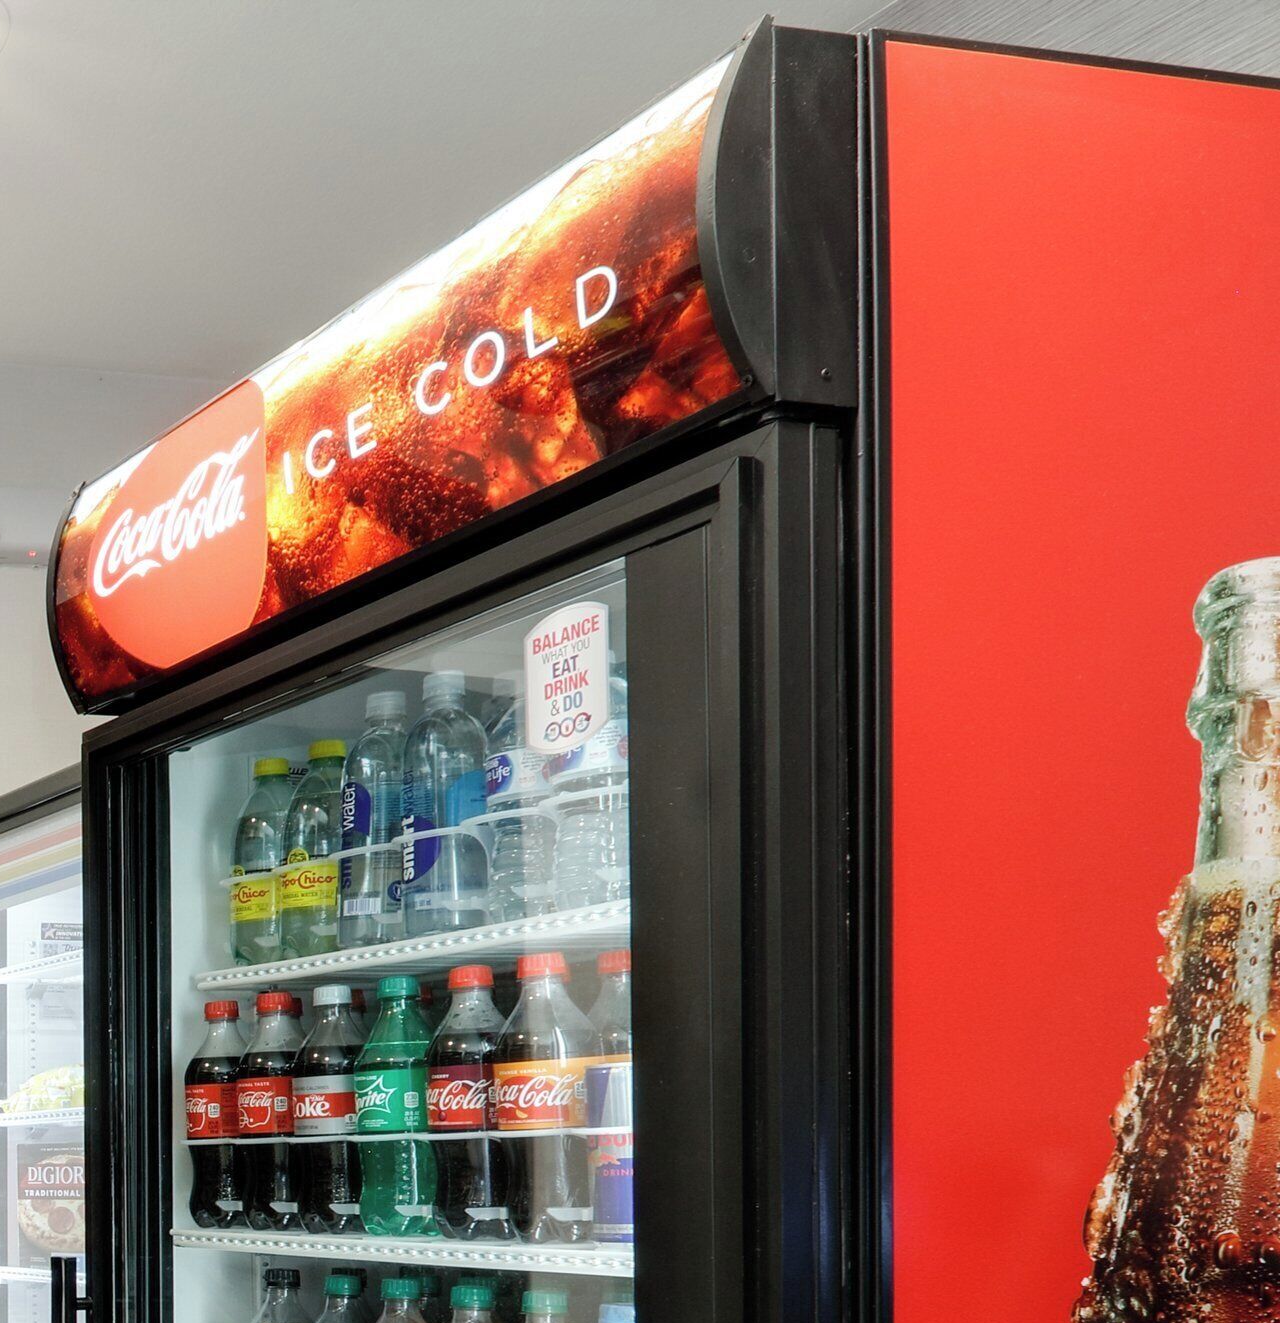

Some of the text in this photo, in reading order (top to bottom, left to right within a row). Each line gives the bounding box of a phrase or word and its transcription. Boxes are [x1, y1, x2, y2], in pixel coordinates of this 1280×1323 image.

[282, 264, 619, 495] ICE COLD
[93, 427, 260, 597] Coca-Cola
[532, 614, 600, 655] BALANCE
[541, 637, 591, 665] WHAT YOU
[544, 670, 589, 700] DRINK
[550, 691, 583, 716] & DO
[297, 870, 338, 890] Chico
[238, 885, 271, 904] Chico
[426, 1078, 492, 1111] ca-Cola
[27, 1166, 85, 1184] DIGIOR
[603, 1169, 634, 1177] DRIN
[24, 1189, 81, 1197] TRADITIONAL
